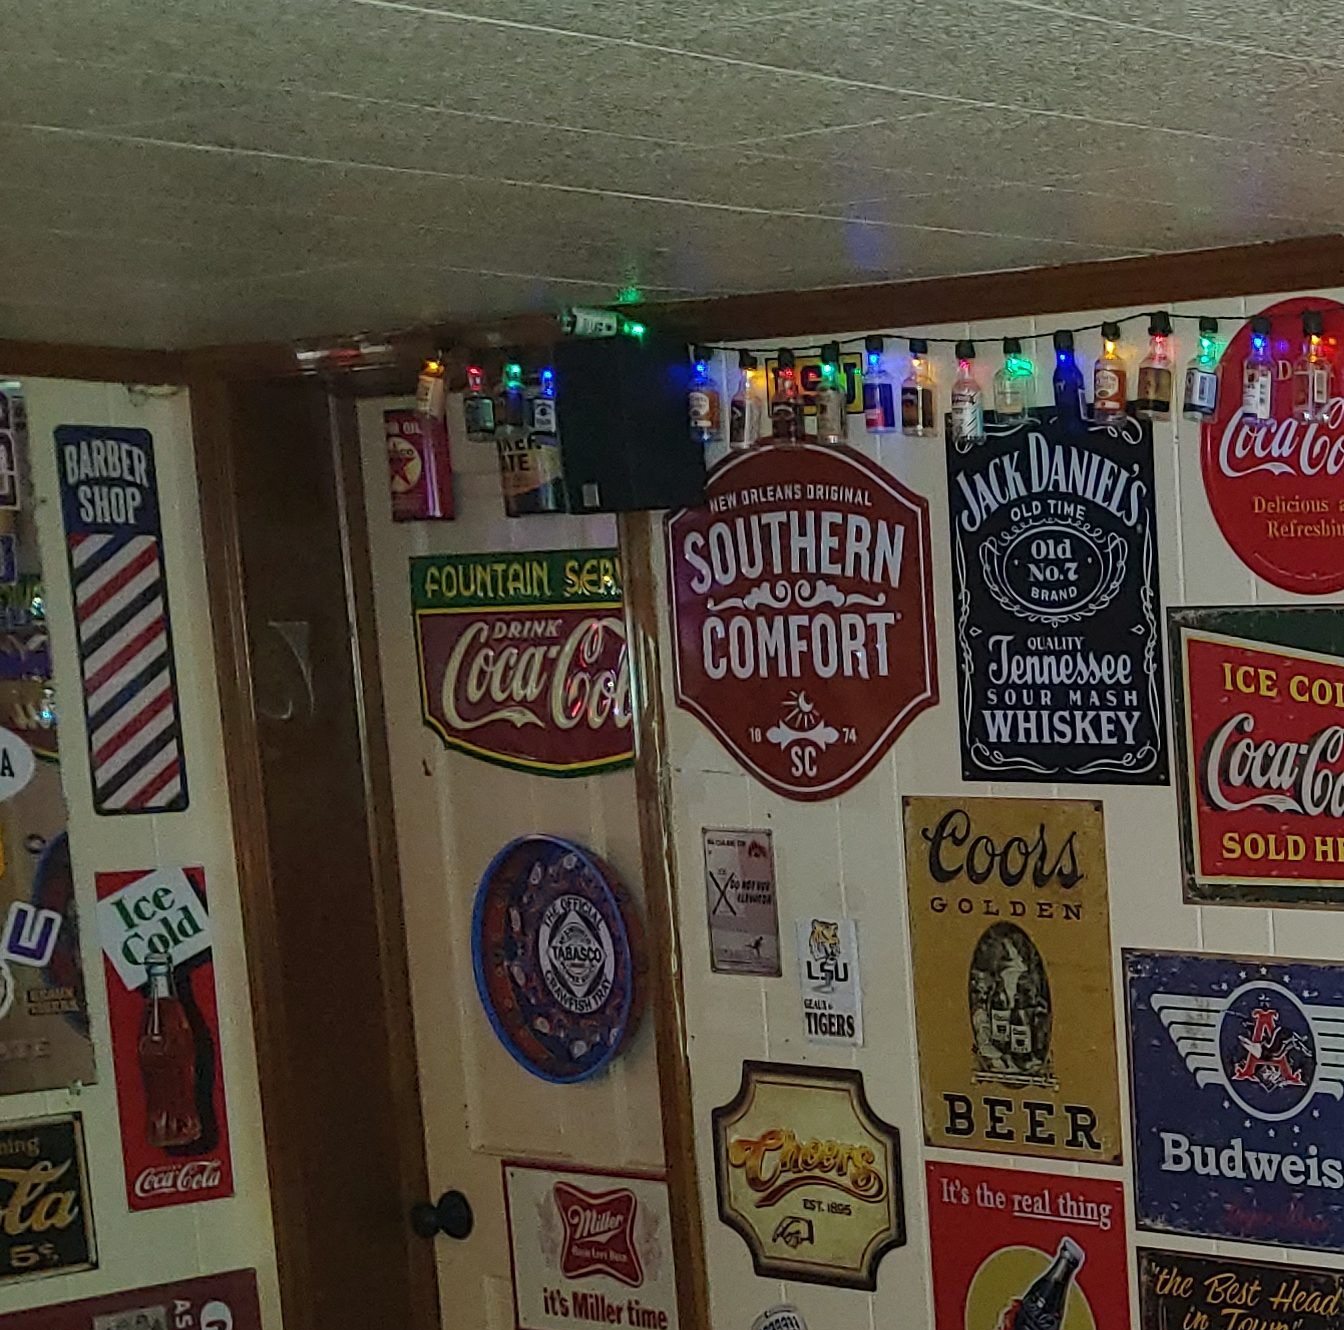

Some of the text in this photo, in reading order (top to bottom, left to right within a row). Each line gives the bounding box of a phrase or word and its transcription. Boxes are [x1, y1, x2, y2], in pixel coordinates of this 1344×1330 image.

[64, 439, 149, 488] BARBER
[79, 484, 141, 524] SHOP
[956, 450, 1028, 532] JACK
[1254, 496, 1329, 514] Delicious
[684, 511, 905, 594] SOUTHERN
[425, 563, 551, 599] FOUNTAIN
[703, 611, 896, 680] COMFORT
[988, 634, 1133, 686] Tennessee
[987, 689, 1139, 707] SOUR MASH
[1223, 663, 1278, 698] ICE
[982, 710, 1142, 745] WHISKEY
[791, 745, 818, 777] SC
[922, 808, 1086, 890] Coors
[1223, 832, 1305, 861] SOLD
[111, 886, 176, 932] Ice
[929, 896, 1083, 921] GOLDEN
[552, 947, 601, 962] TABASCO
[804, 1012, 855, 1038] TIGERS
[941, 1092, 1102, 1151] BEER
[134, 1161, 221, 1197] Coca-Cola
[976, 1184, 1113, 1230] the thing
[572, 1291, 668, 1330] Miller time
[1204, 1273, 1341, 1316] Best Head
